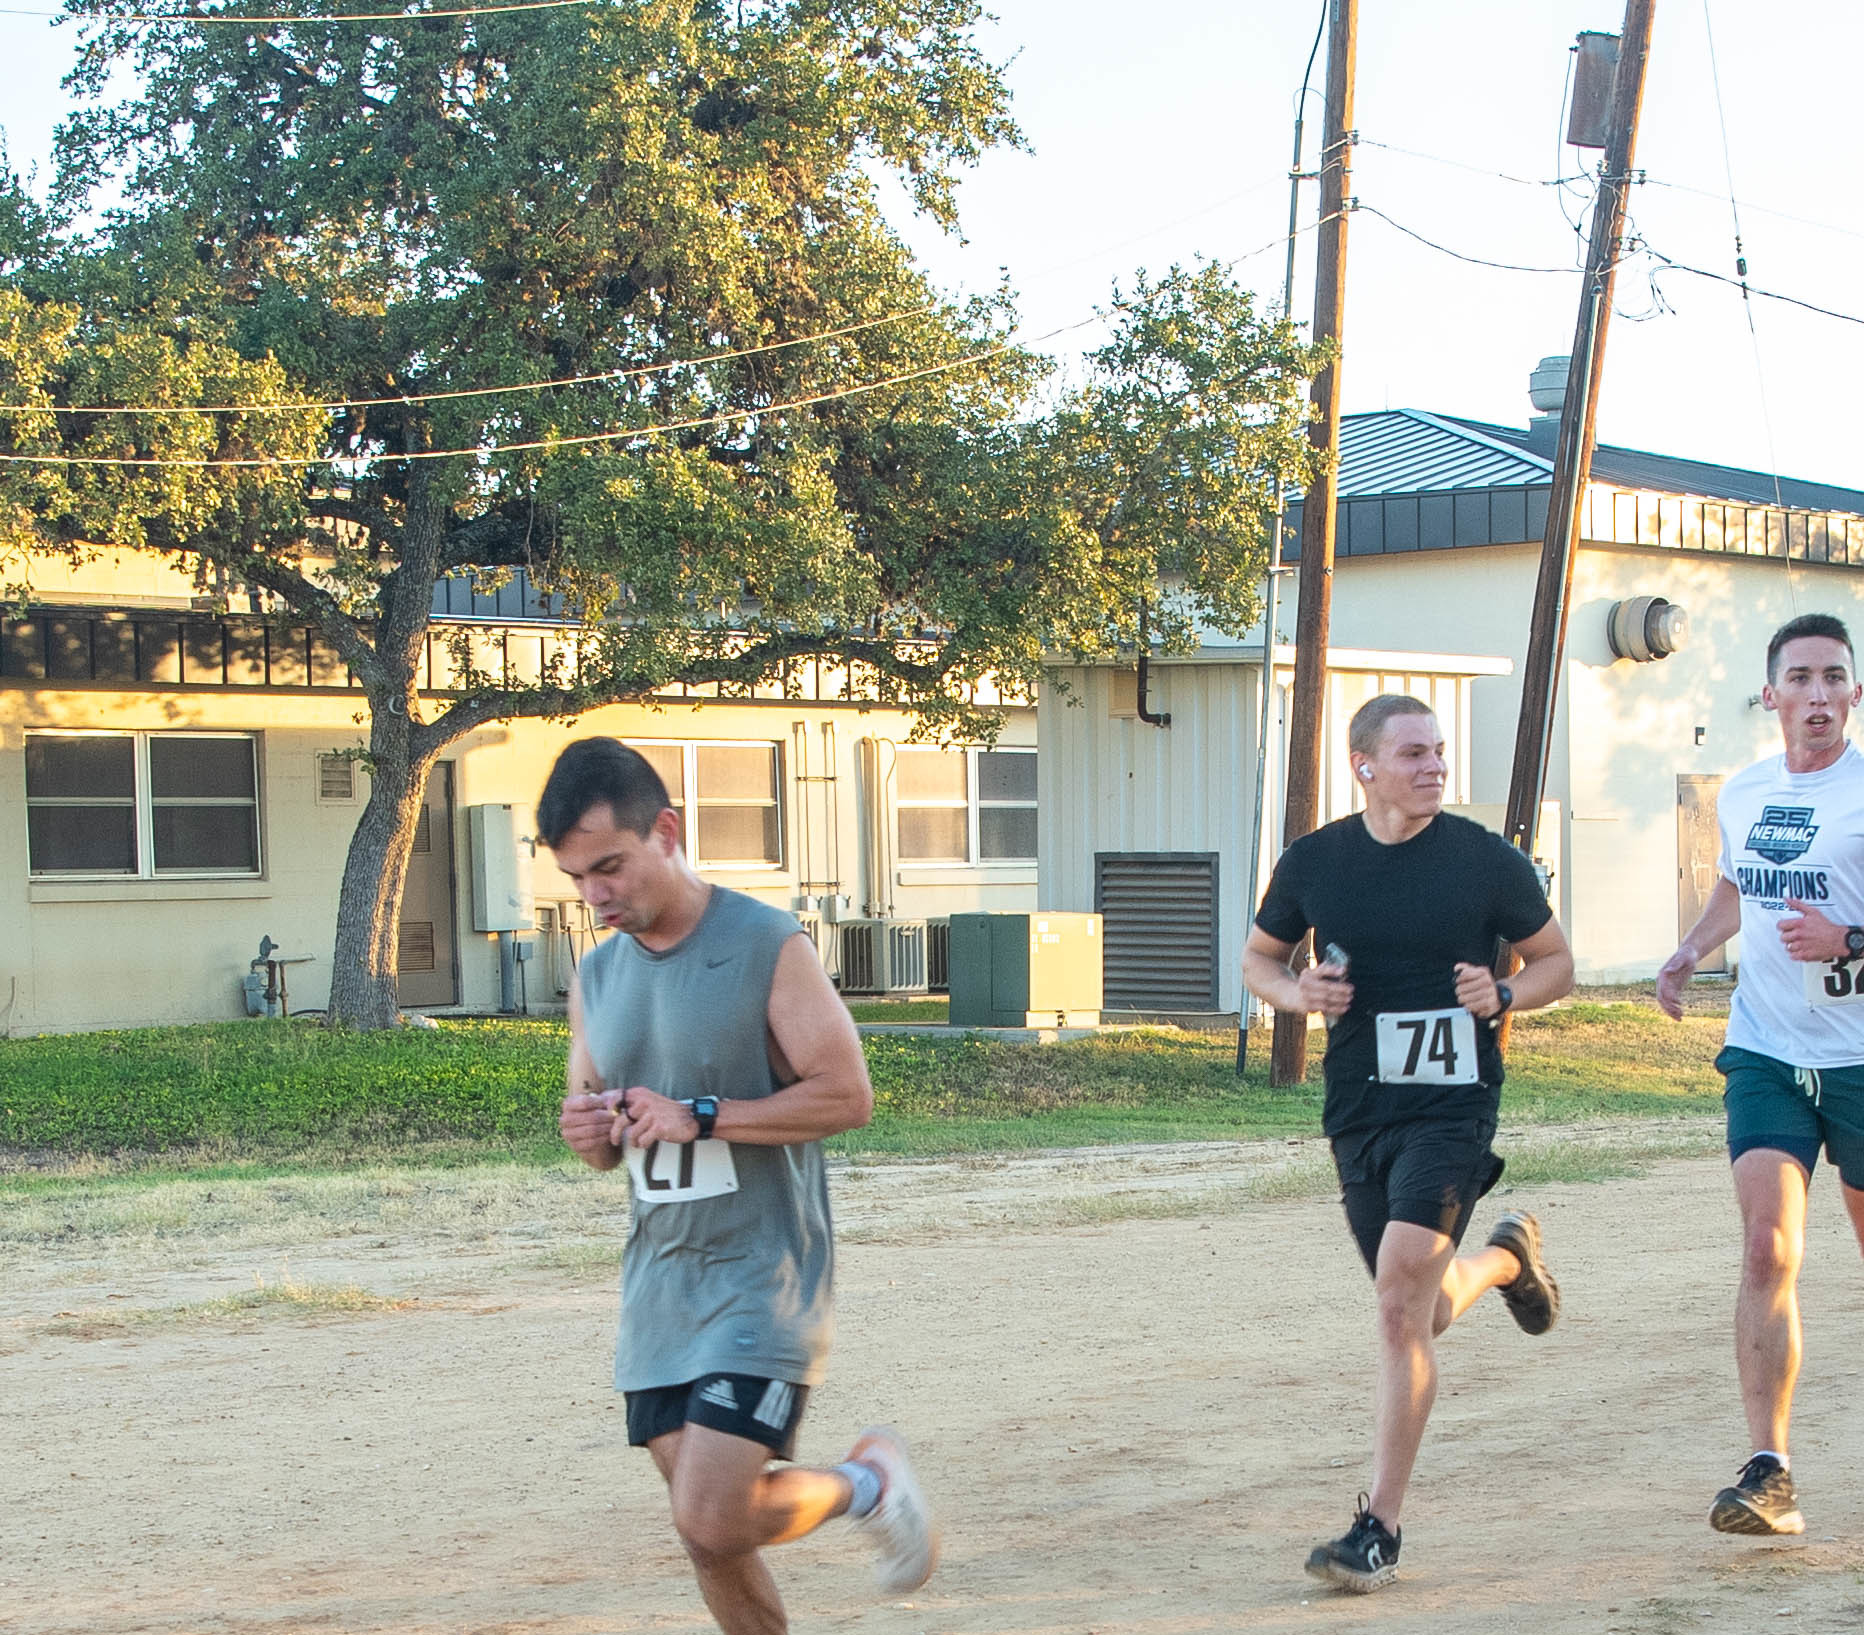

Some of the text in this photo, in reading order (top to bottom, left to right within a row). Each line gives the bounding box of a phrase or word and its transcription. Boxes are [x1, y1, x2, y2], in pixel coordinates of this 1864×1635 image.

[1766, 809, 1809, 825] 25
[1750, 825, 1816, 842] NEWMAC
[1737, 867, 1829, 900] CHAMPIONS
[1396, 1016, 1458, 1076] 74
